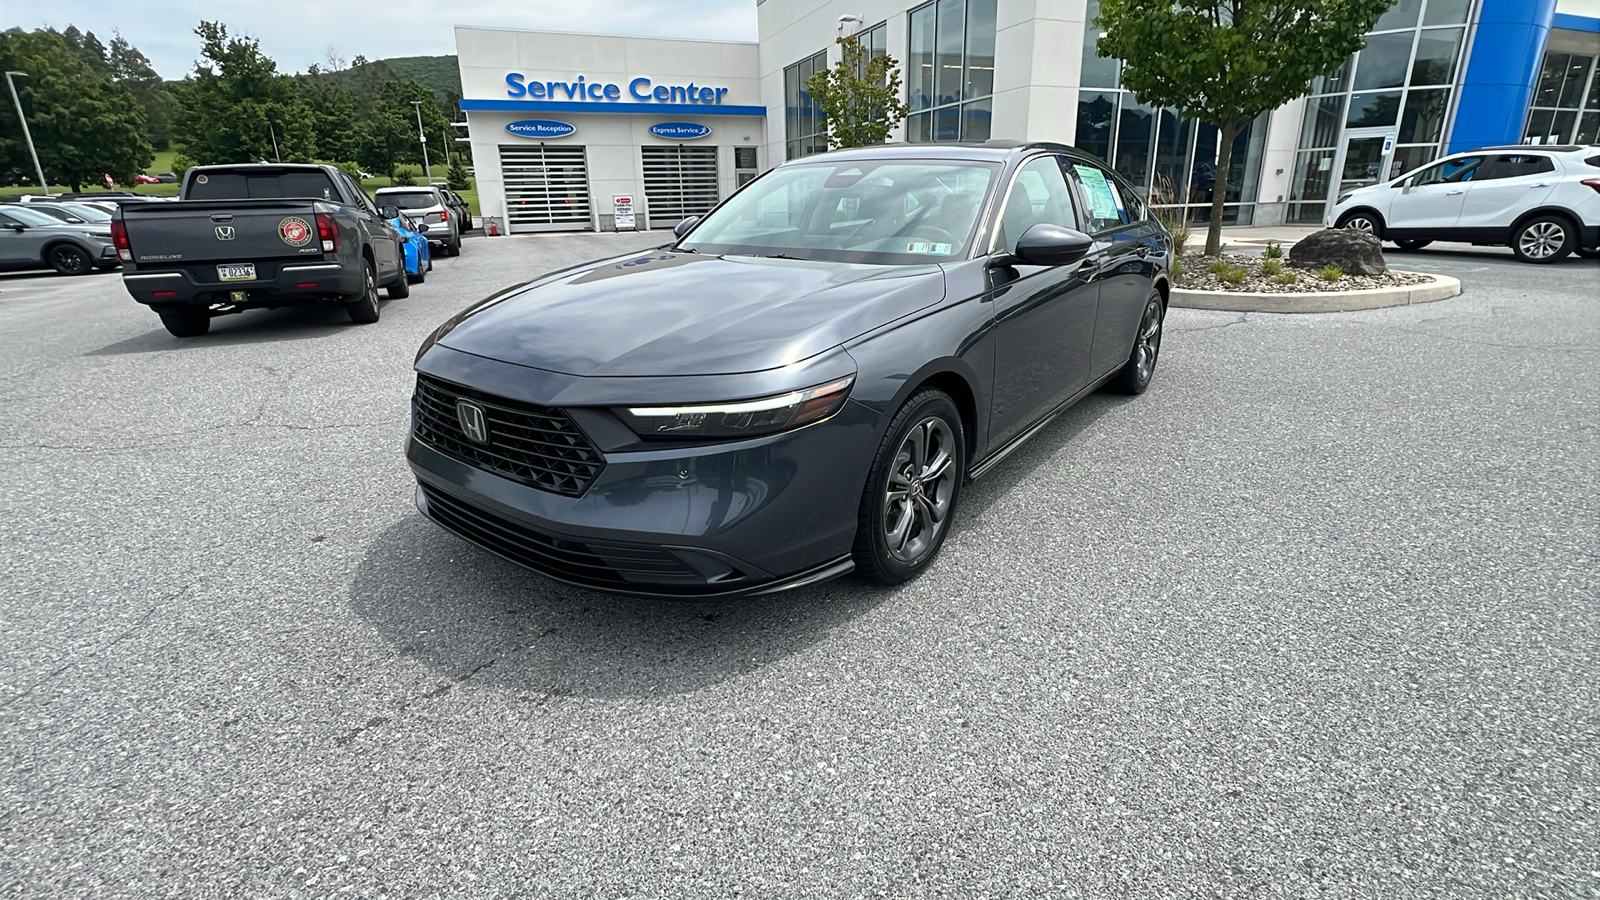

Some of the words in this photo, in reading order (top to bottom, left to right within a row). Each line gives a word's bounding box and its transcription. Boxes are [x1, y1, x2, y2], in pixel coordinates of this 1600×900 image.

[505, 72, 621, 100] Service
[628, 77, 729, 104] Center
[509, 124, 536, 132] Service
[537, 124, 572, 133] Reception
[652, 126, 676, 135] Express
[676, 126, 699, 134] Service
